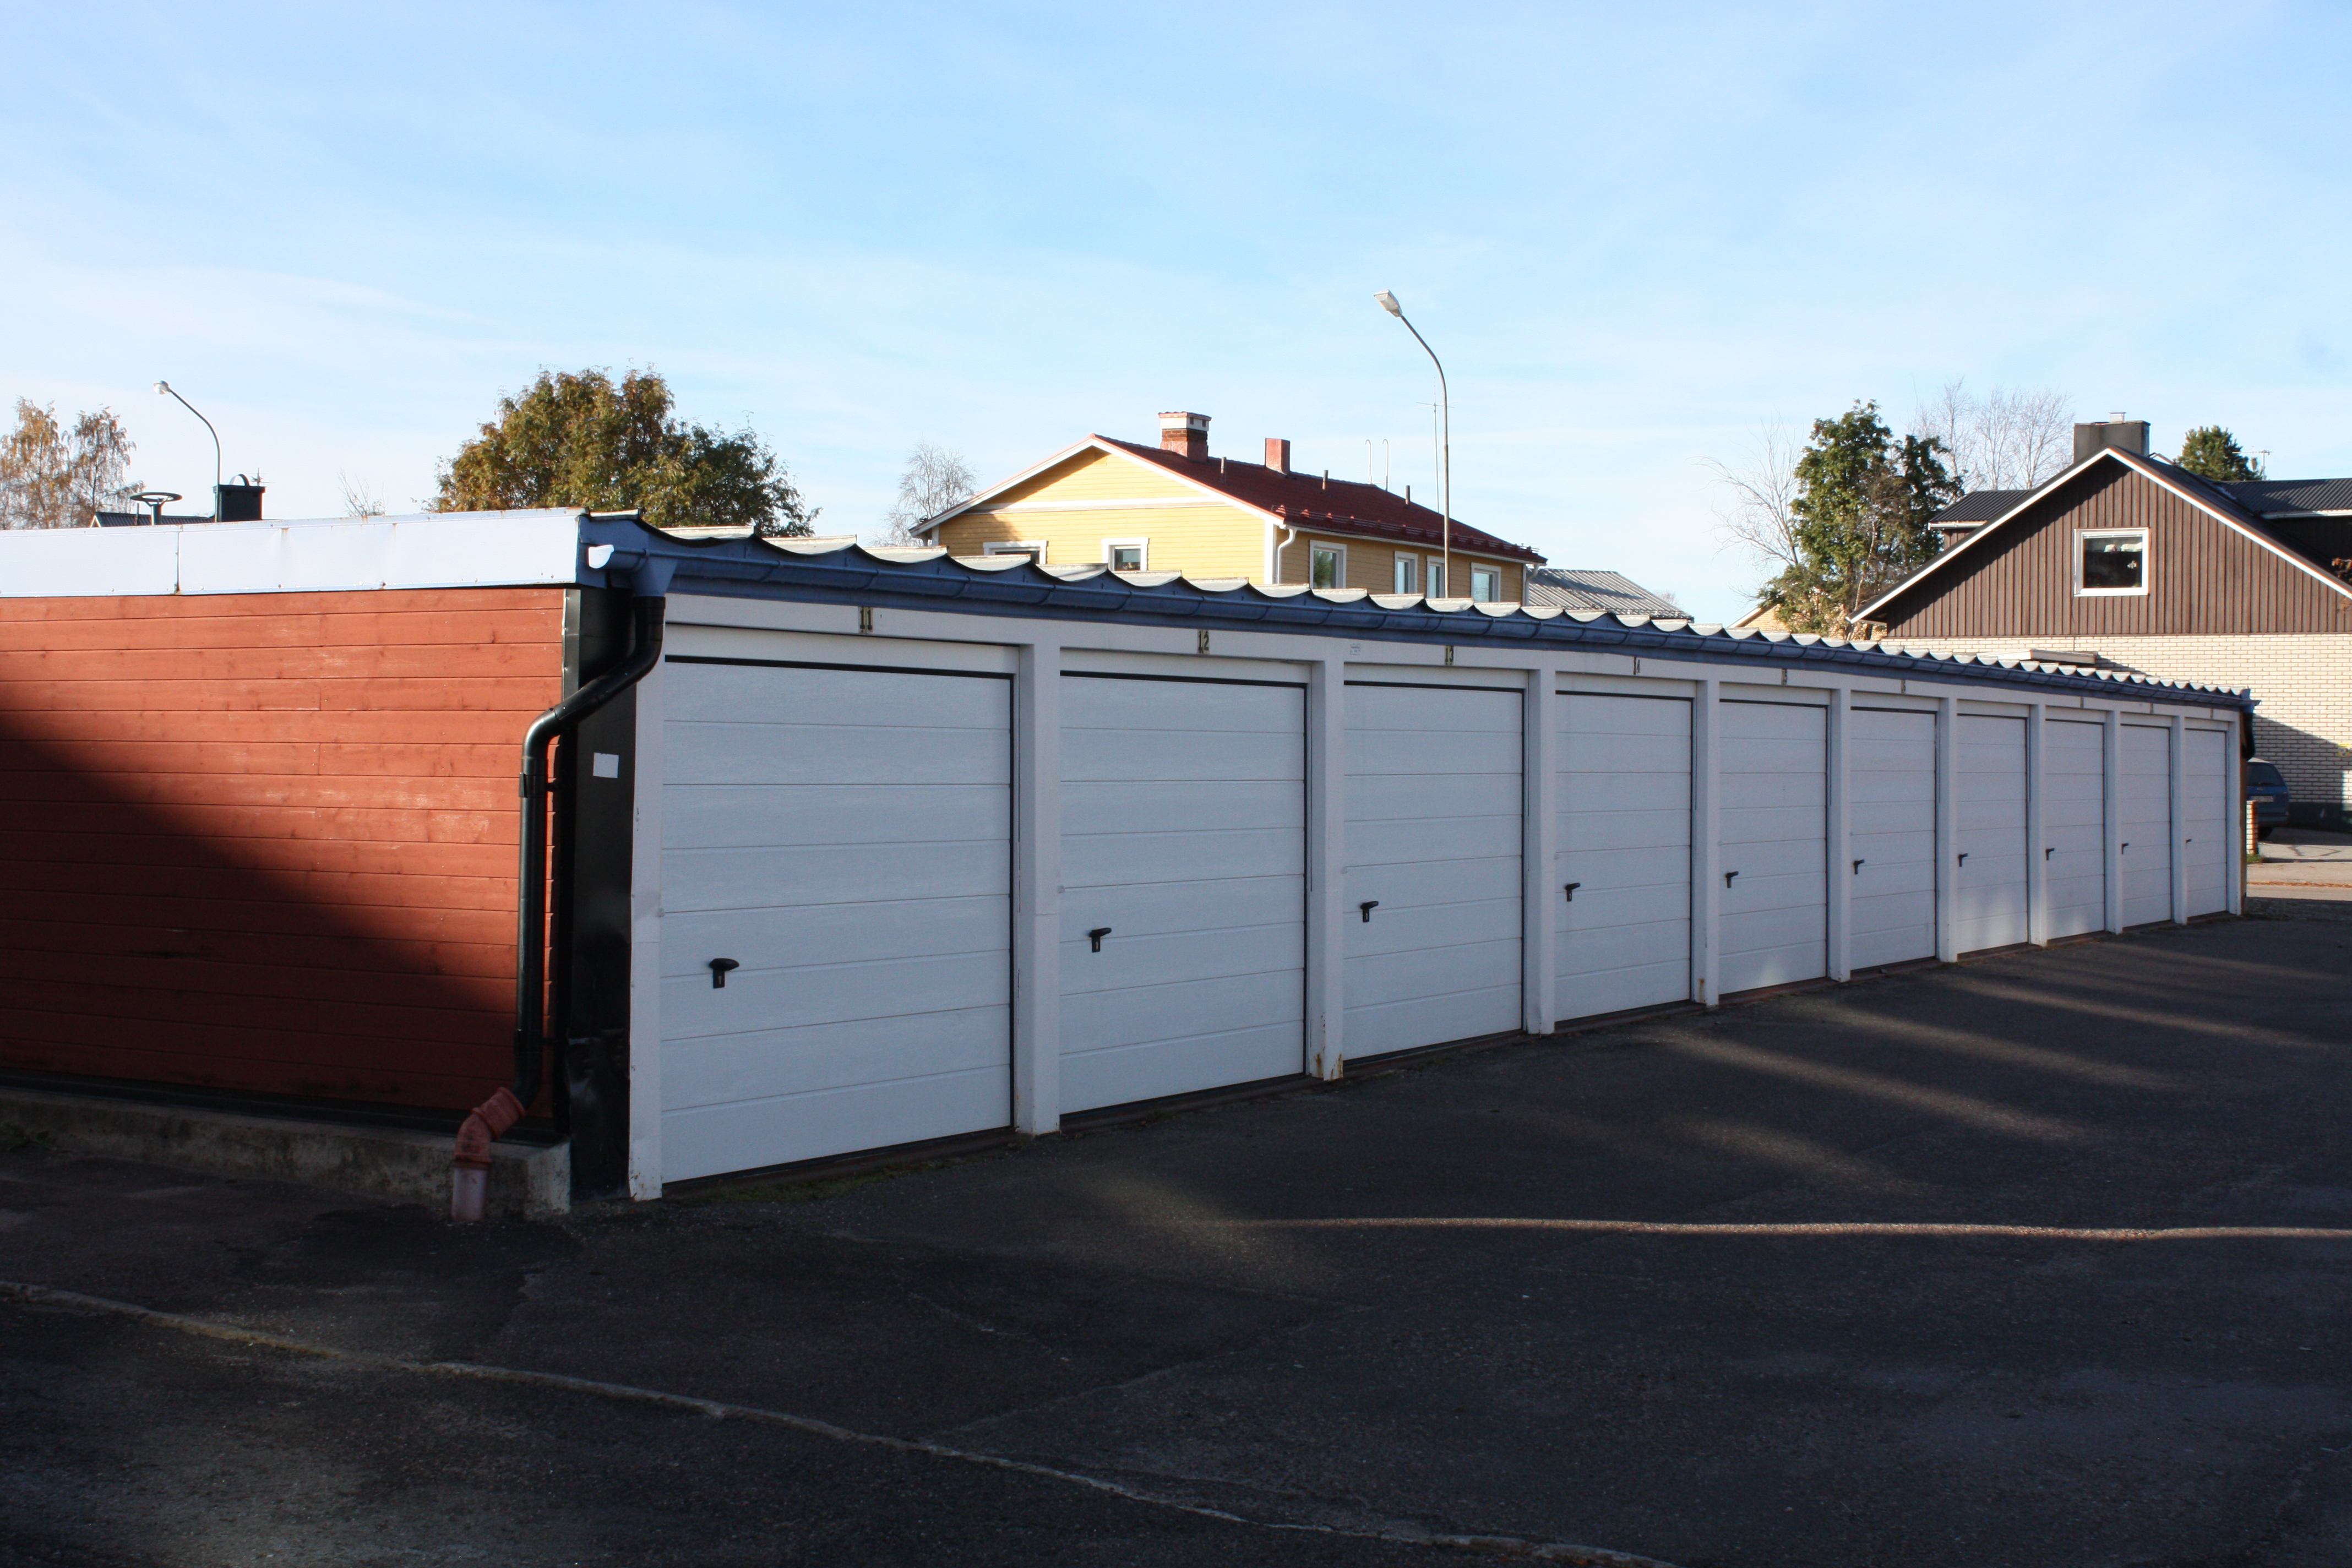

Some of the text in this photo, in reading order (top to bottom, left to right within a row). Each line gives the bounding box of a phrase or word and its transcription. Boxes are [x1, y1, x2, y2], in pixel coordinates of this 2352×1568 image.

[860, 608, 873, 630] 11
[1198, 633, 1209, 651] 12
[1445, 646, 1453, 662] 13
[1633, 657, 1640, 675] 14
